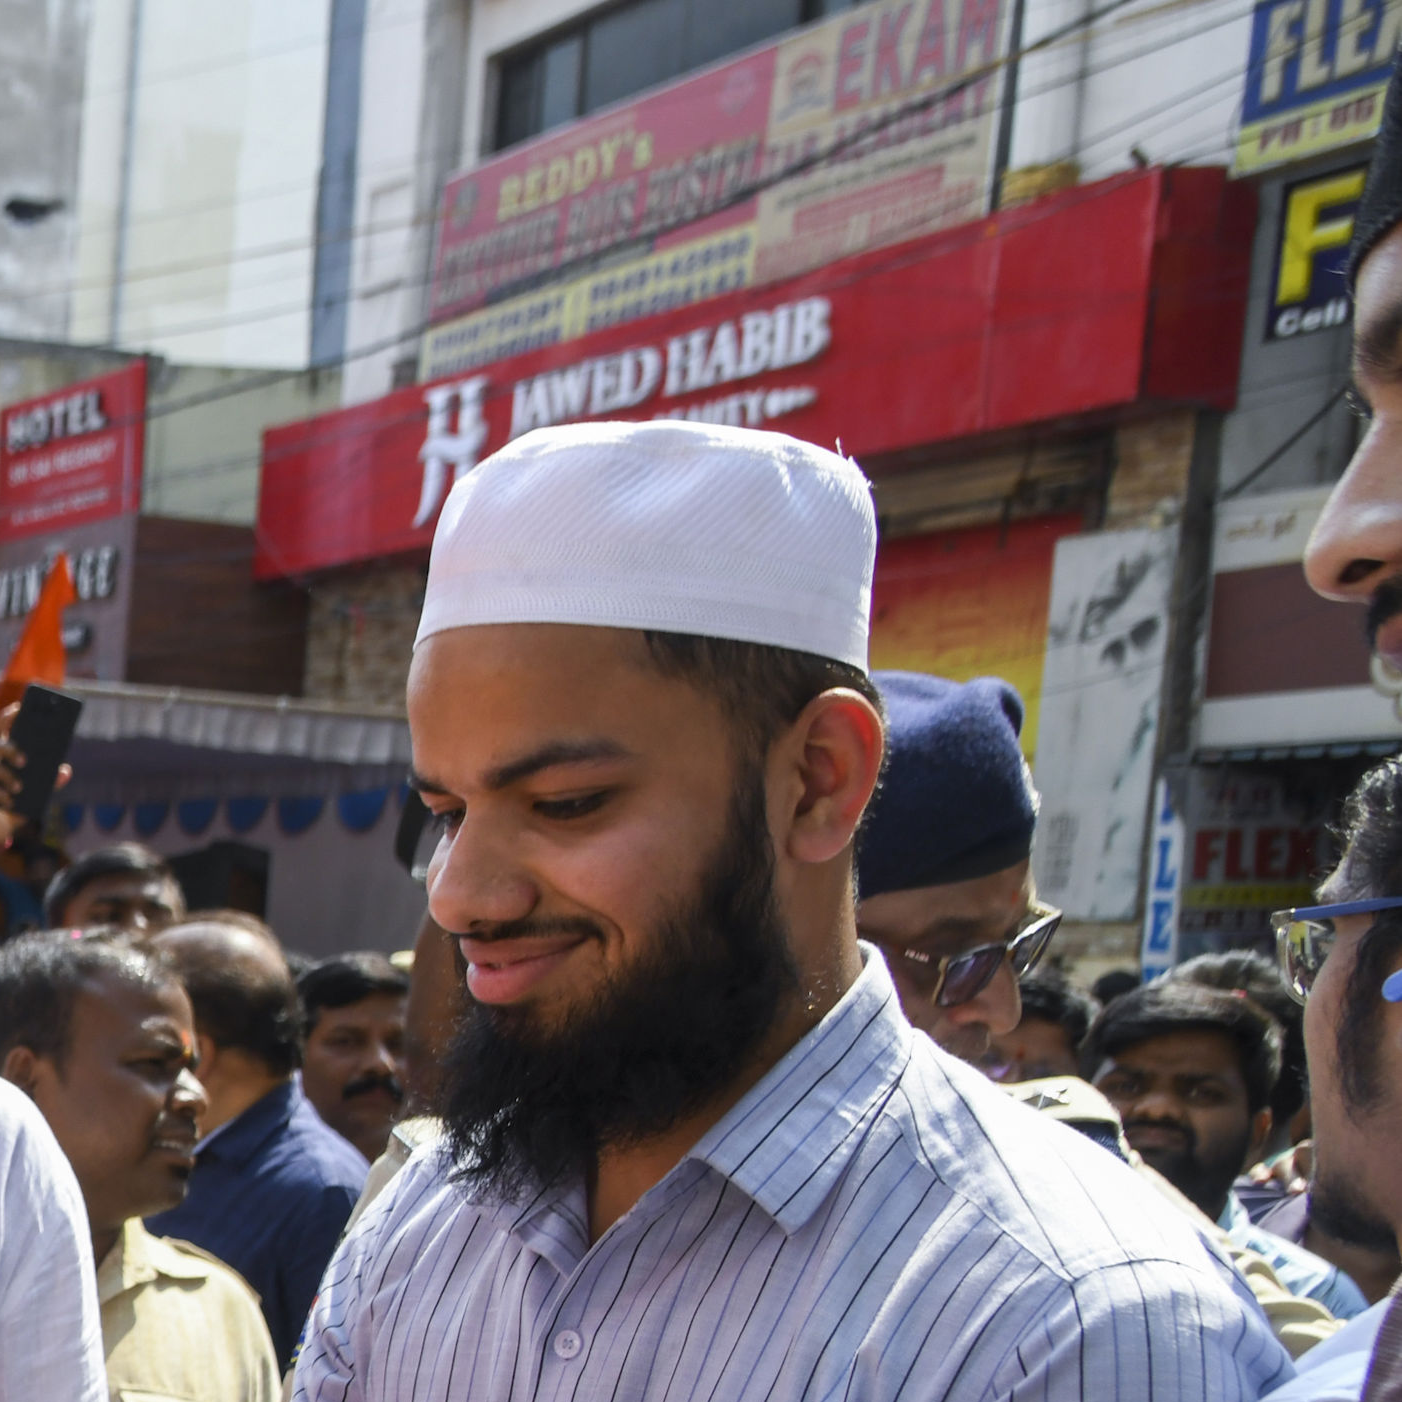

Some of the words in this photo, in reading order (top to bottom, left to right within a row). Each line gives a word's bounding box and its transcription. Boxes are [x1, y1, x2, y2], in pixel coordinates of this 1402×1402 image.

[510, 347, 661, 442] JAWED
[663, 296, 833, 397] HABIB
[7, 390, 106, 453] HOTEL
